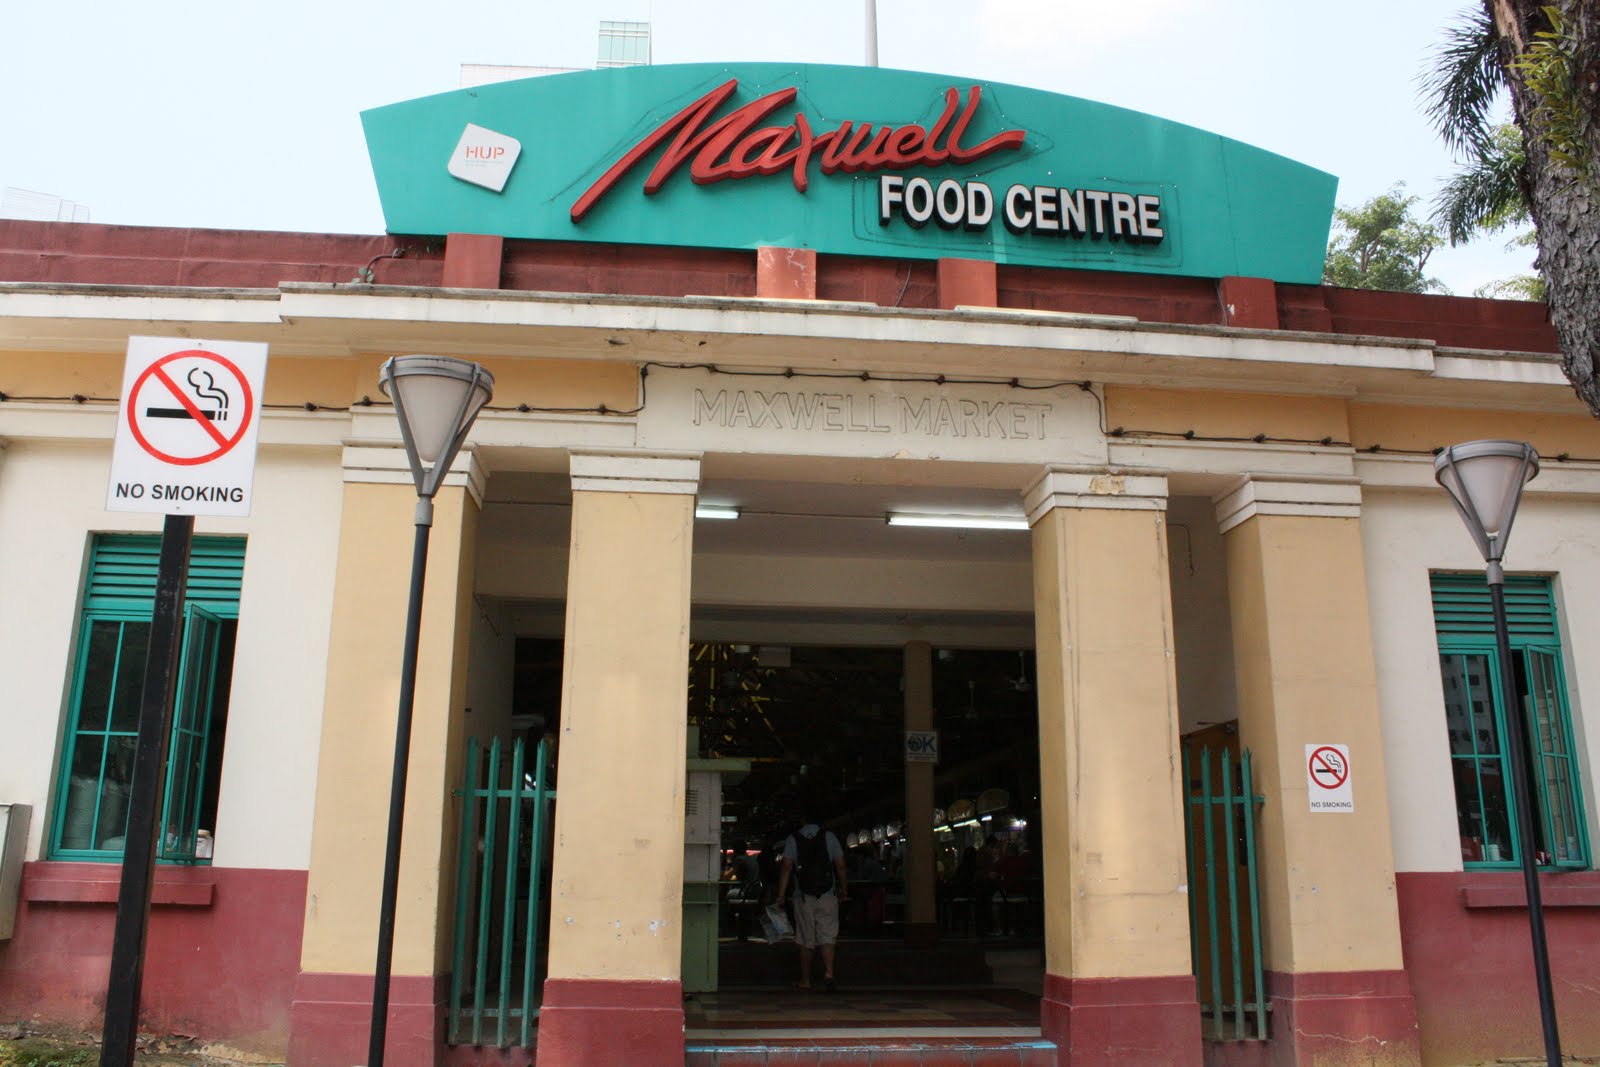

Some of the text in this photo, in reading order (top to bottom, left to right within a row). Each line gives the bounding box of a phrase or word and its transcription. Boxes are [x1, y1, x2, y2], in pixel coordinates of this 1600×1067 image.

[465, 145, 505, 160] HUP
[571, 79, 1026, 223] Maxwell
[879, 174, 1165, 244] FOOD CENTRE
[693, 388, 1054, 440] MAXWELL MARKET
[115, 482, 244, 503] NO SMOKING
